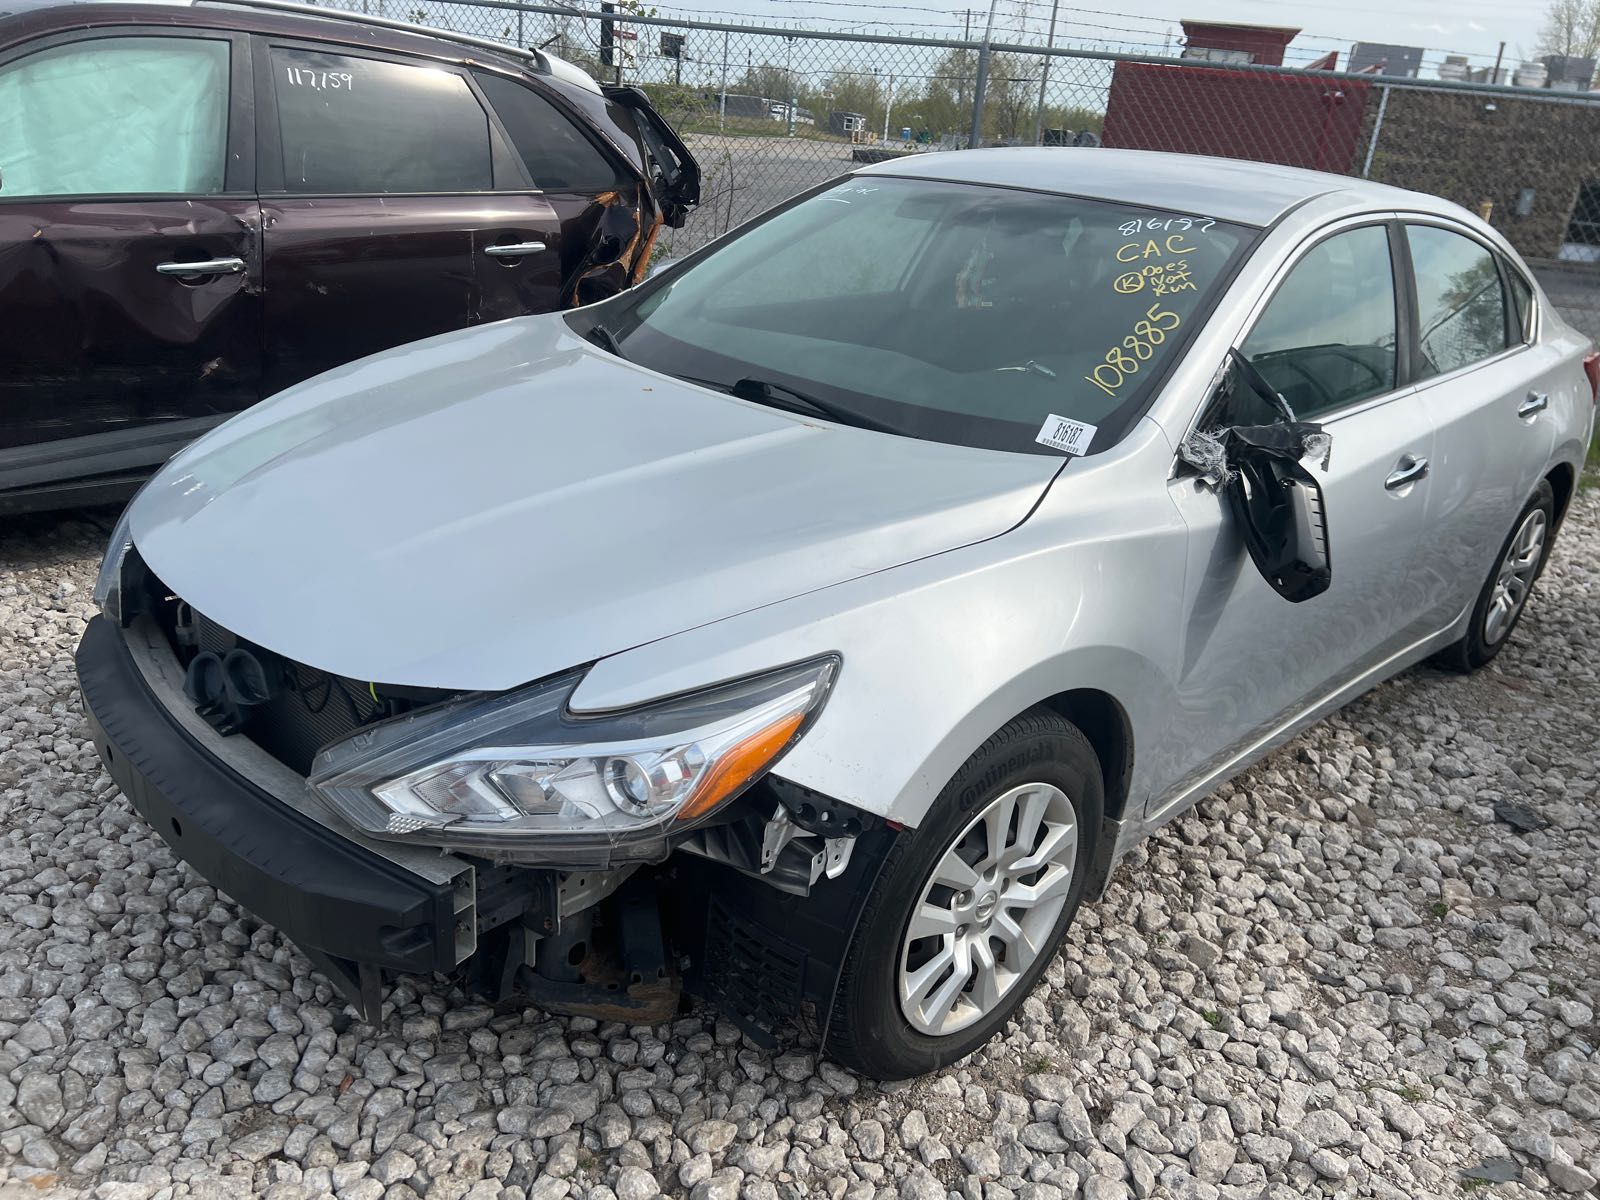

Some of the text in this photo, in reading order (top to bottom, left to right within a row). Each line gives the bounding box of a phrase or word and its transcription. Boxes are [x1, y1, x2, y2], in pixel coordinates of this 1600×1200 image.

[1115, 234, 1198, 263] CAC
[1142, 259, 1188, 277] Does
[1150, 270, 1193, 286] Not
[1084, 302, 1181, 397] 108885
[1052, 422, 1084, 446] 816187
[959, 740, 1045, 812] Continental
